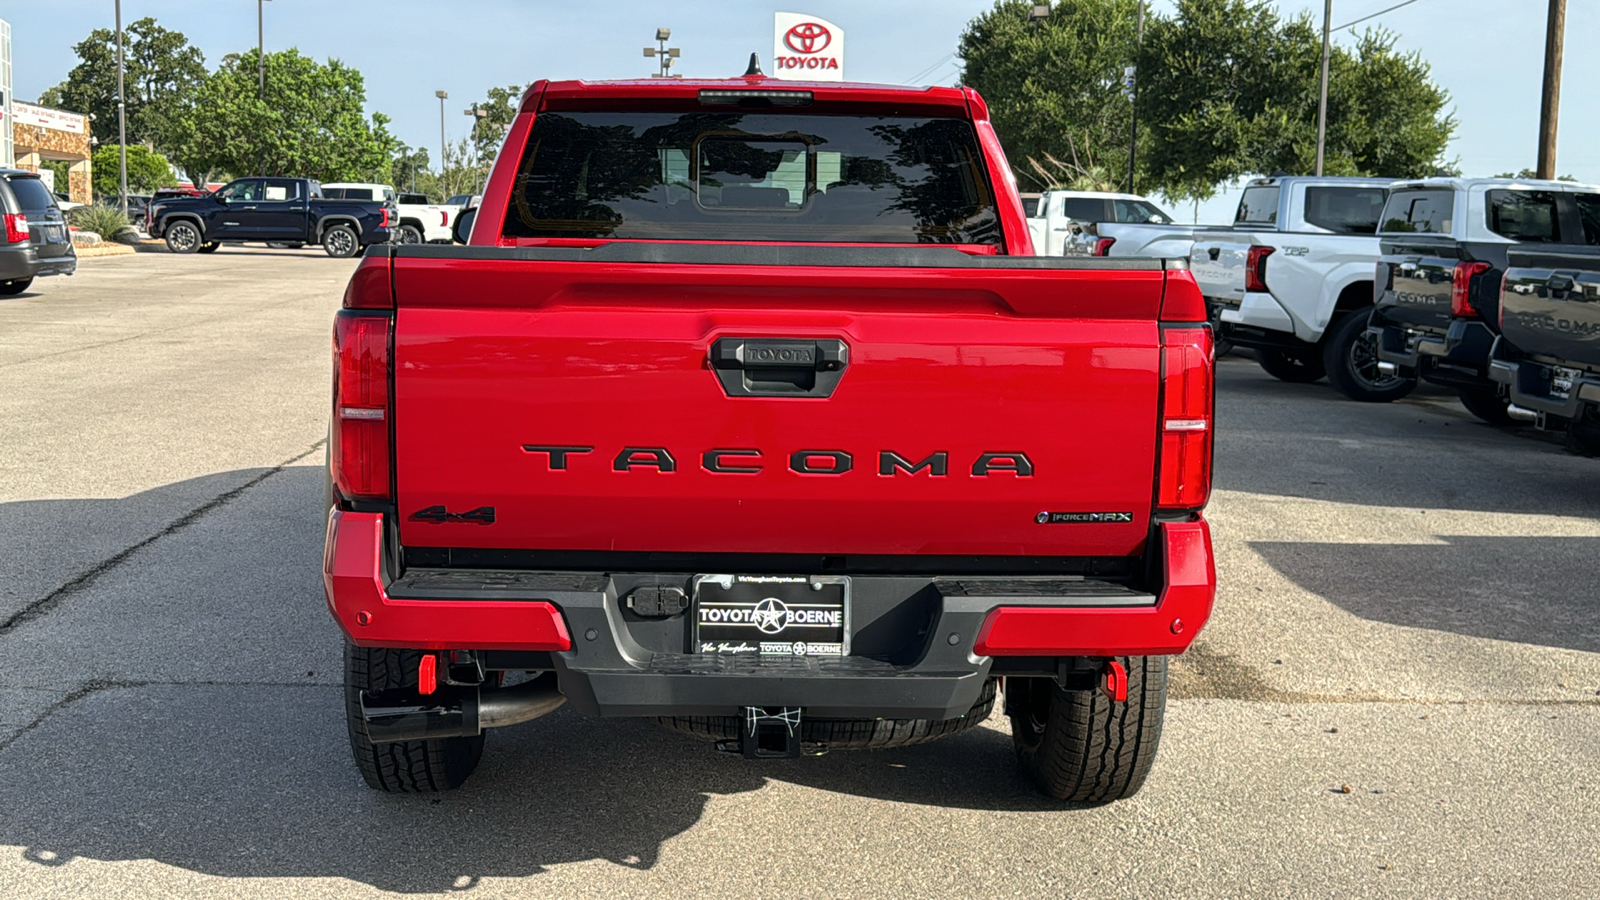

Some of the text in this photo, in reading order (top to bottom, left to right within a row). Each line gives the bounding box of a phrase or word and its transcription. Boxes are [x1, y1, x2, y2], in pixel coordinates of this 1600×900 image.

[776, 56, 839, 70] TOYOTA
[747, 348, 813, 362] TOYOTA
[520, 445, 1035, 478] TACOMA
[700, 608, 762, 622] TOYOTA
[786, 610, 842, 623] BOERNE
[760, 644, 841, 653] TOYOTA BOERNE
